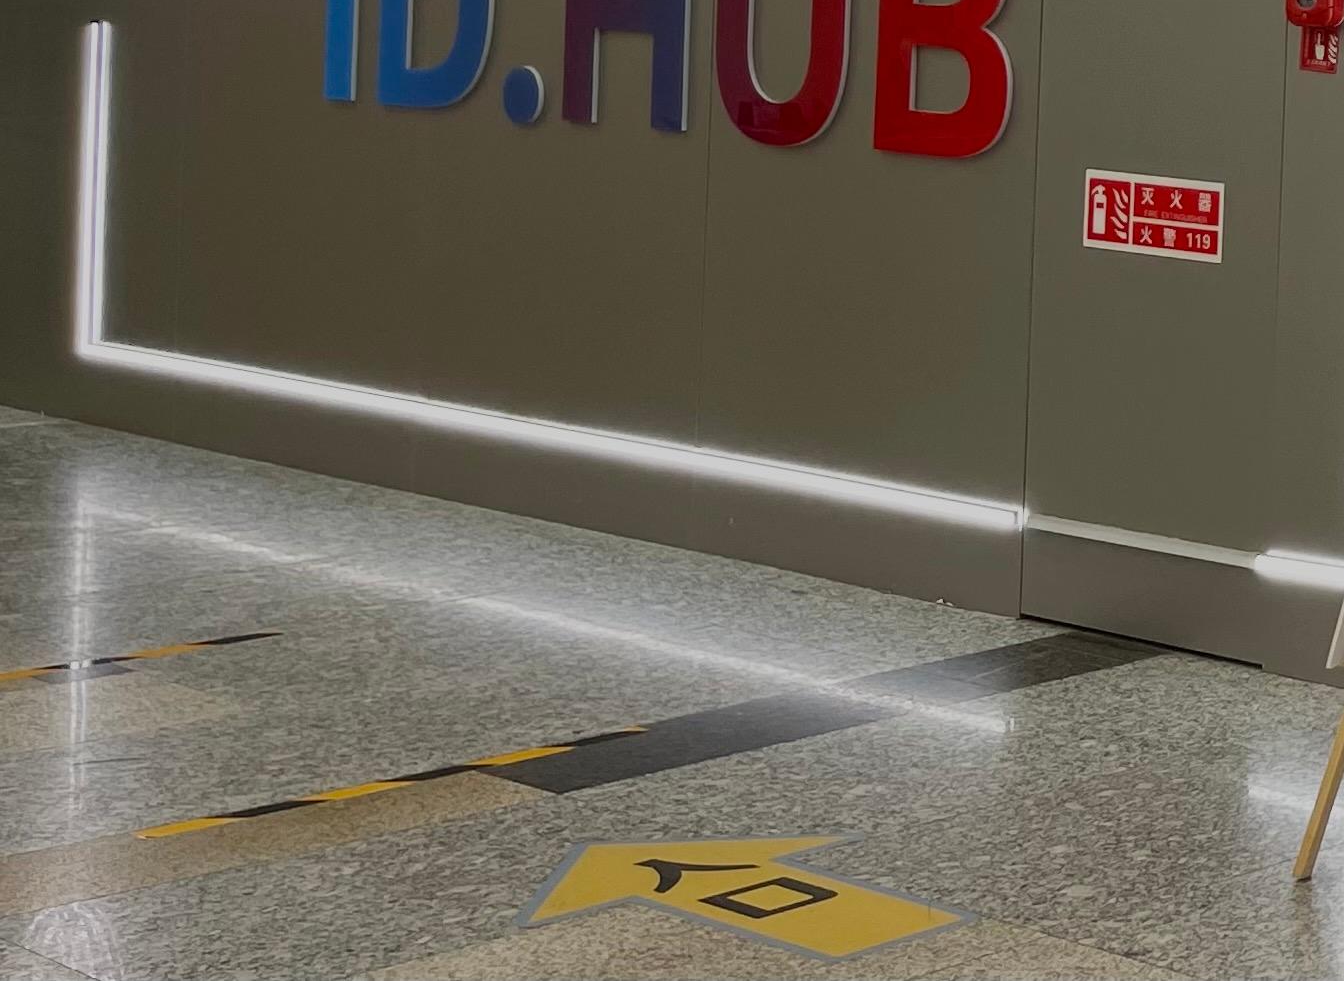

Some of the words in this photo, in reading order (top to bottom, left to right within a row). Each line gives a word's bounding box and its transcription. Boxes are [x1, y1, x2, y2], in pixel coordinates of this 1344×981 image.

[1141, 187, 1212, 212] 灭火器
[1140, 226, 1177, 247] 火警
[1186, 233, 1211, 250] 119
